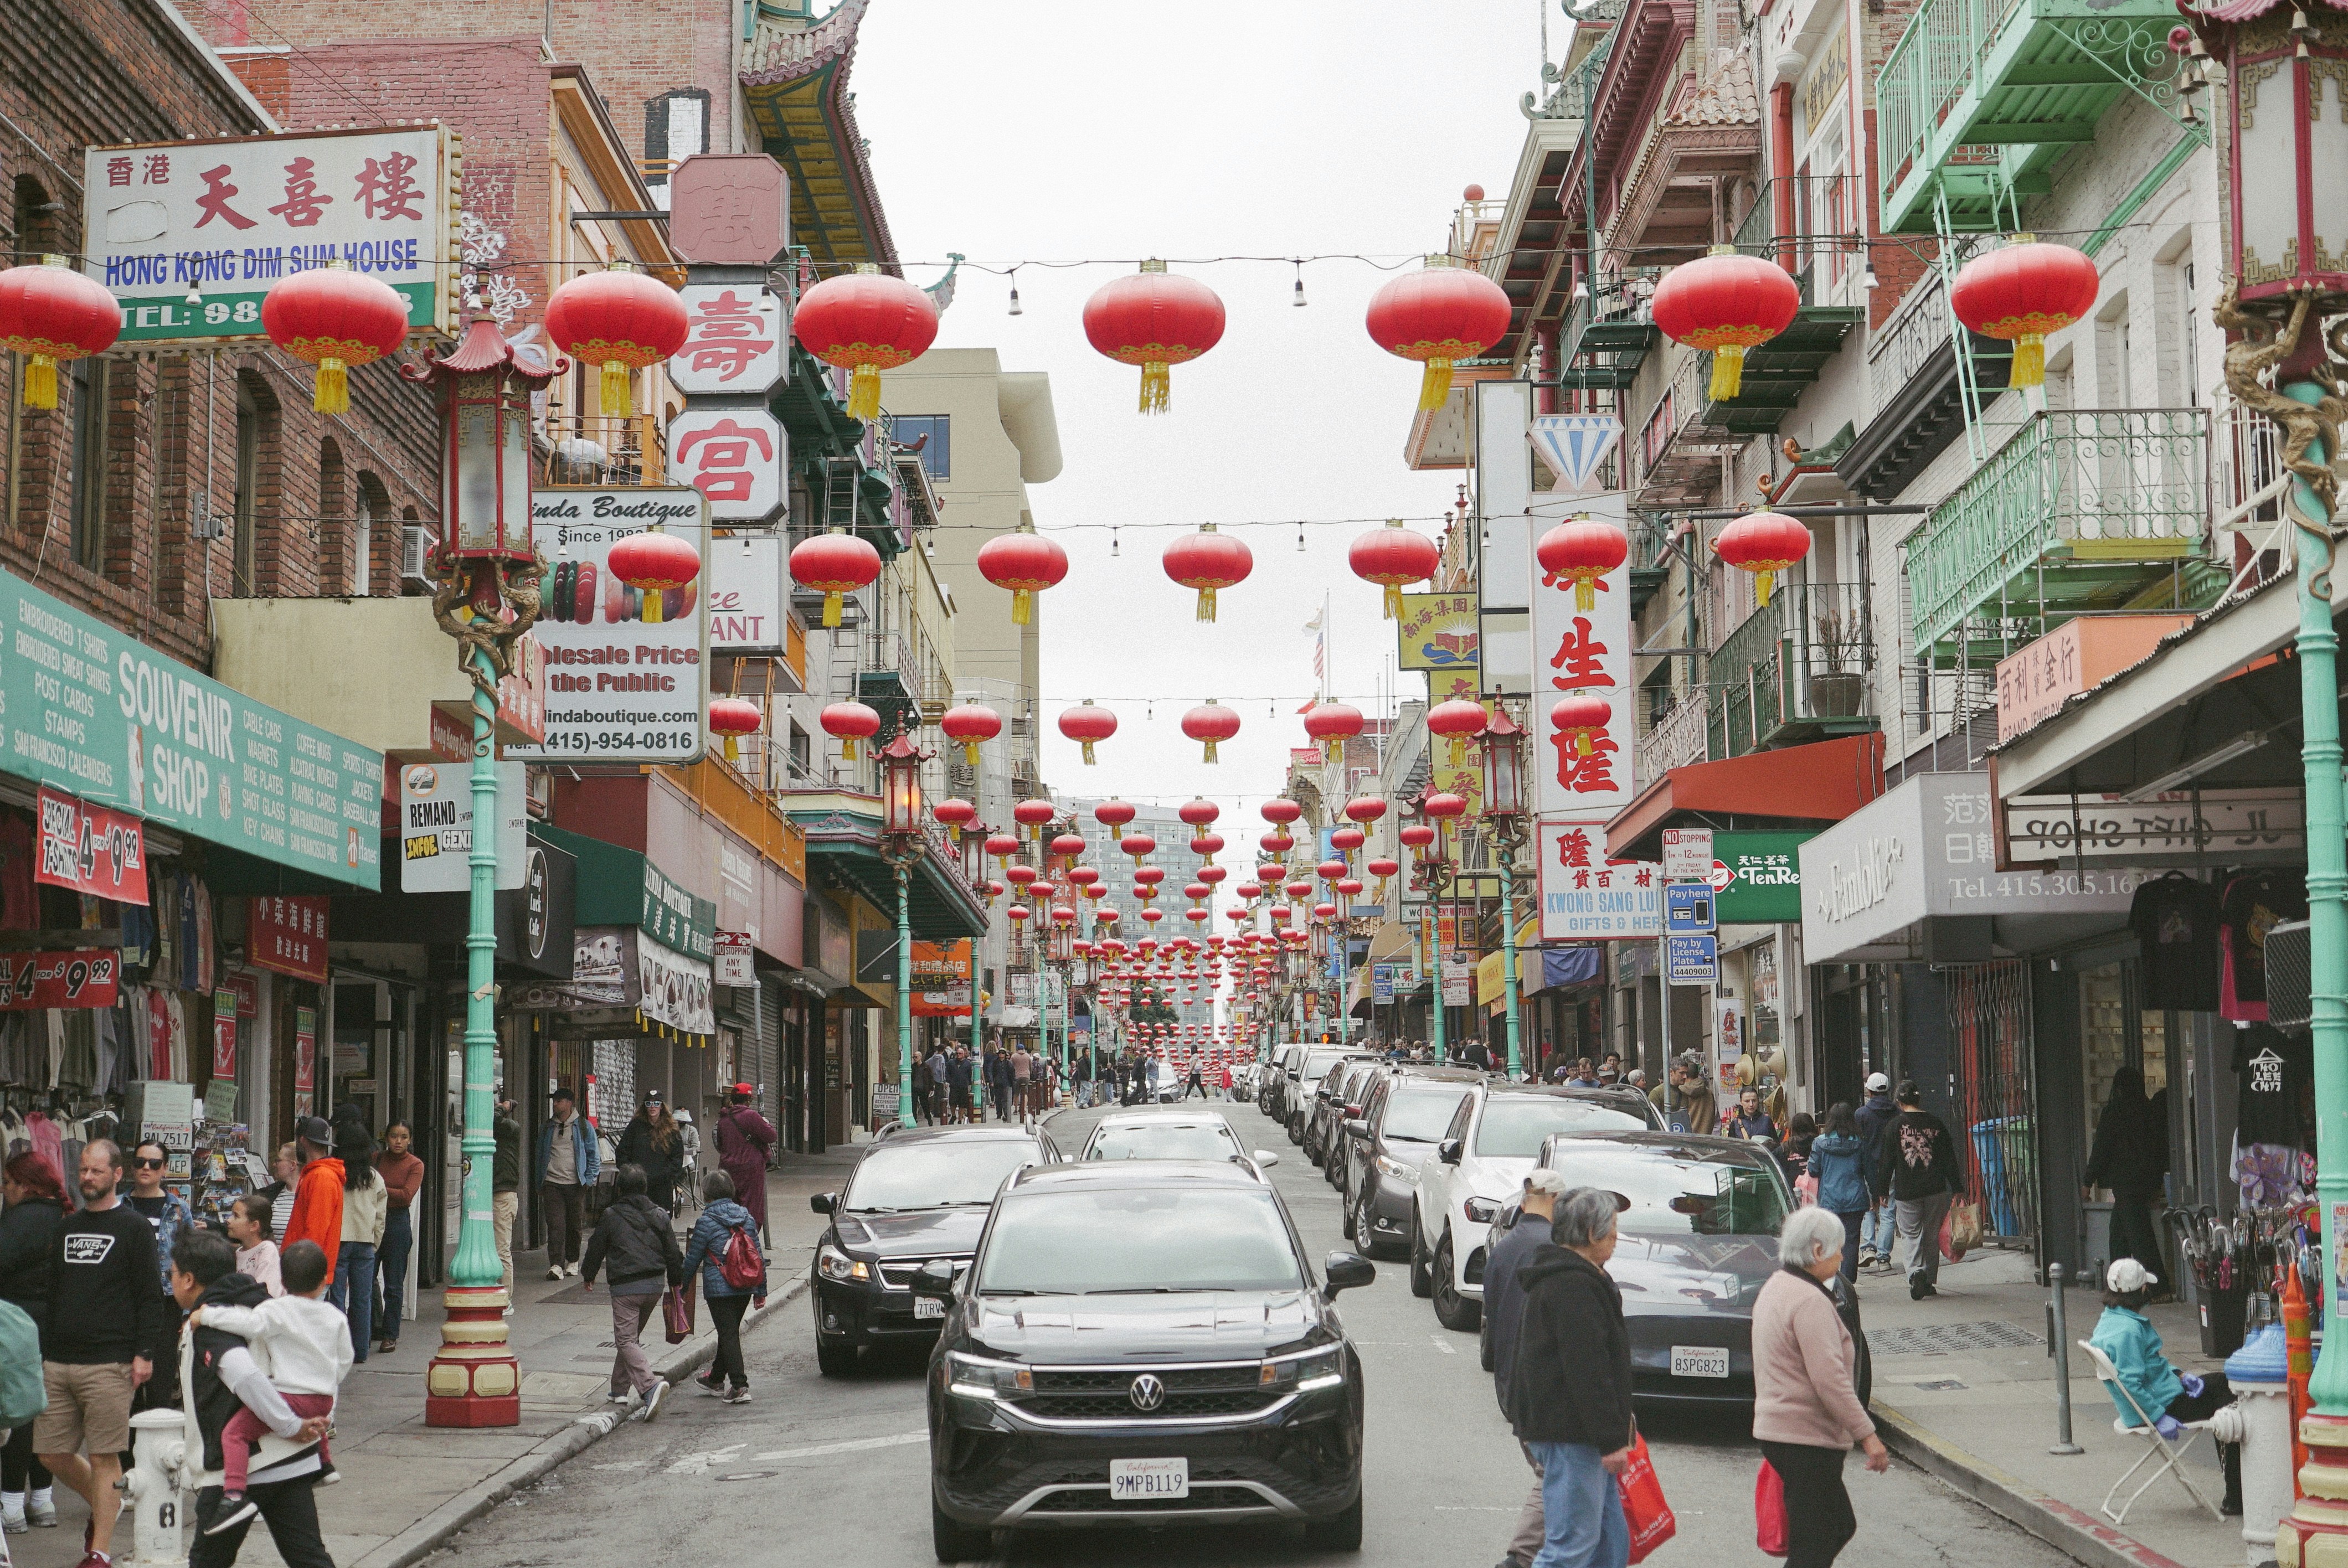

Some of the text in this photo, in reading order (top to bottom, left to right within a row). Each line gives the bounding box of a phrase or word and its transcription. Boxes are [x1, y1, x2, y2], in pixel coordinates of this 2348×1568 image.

[107, 154, 171, 187] 香港
[193, 151, 425, 230] 天喜樓
[106, 239, 418, 287] HONG KONG DIM SUM HOUSE
[532, 496, 697, 524] inda Boutique
[557, 529, 602, 543] Since
[635, 645, 699, 665] Price
[86, 663, 111, 695] SHIRTS
[552, 673, 675, 693] the Public
[35, 671, 60, 704] POST
[64, 684, 94, 718] CARDS
[119, 651, 235, 764] SOUVENIR
[45, 709, 85, 745] STAMPS
[243, 709, 282, 743] CABLE CARS
[248, 738, 278, 768] MAGNETS
[296, 732, 316, 757] COFFEE
[539, 731, 693, 754] (415)-954-0816
[152, 743, 209, 819] SHOP
[243, 762, 284, 796] BIKE PLATES
[351, 779, 373, 803] JACKETS
[242, 788, 285, 822] SHOT GLASS
[316, 790, 337, 814] CARDS
[343, 800, 369, 826] BASEBALL
[410, 801, 456, 828] REMAND
[243, 816, 258, 837] KEY
[1665, 831, 1711, 844] NO STOPPING
[80, 817, 105, 880] 4 FOR
[359, 836, 377, 864] Hanes
[1738, 854, 1790, 866] 天仁茗茶
[531, 868, 543, 890] Lady
[1738, 866, 1801, 885] TenRe
[645, 864, 692, 919] LINDA BOUTIQUE
[1670, 888, 1711, 900] Pay here
[1948, 876, 1992, 899] Tel.
[529, 894, 542, 913] Luck
[1459, 907, 1469, 916] FIX
[1547, 891, 1634, 915] KWONG SANG
[529, 916, 539, 937] Cafe
[1569, 916, 1626, 932] GIFTS &
[1443, 932, 1455, 942] REPA
[1672, 938, 1702, 949] Pay by
[714, 945, 750, 956] NO STOPPING
[1672, 948, 1705, 956] License
[1672, 957, 1695, 965] Plate
[725, 968, 742, 978] TIME
[726, 958, 740, 967] ANY
[14, 960, 37, 1000] 4
[35, 970, 53, 980] FOR
[2256, 1072, 2280, 1082] LEE
[878, 1084, 898, 1093] OPEN
[73, 1238, 103, 1250] VANS
[918, 1303, 940, 1315] 7TRV
[1682, 1349, 1719, 1357] California
[1674, 1358, 1726, 1373] 8SPG823
[1126, 1462, 1173, 1473] California
[1116, 1474, 1182, 1493] 9MPB119
